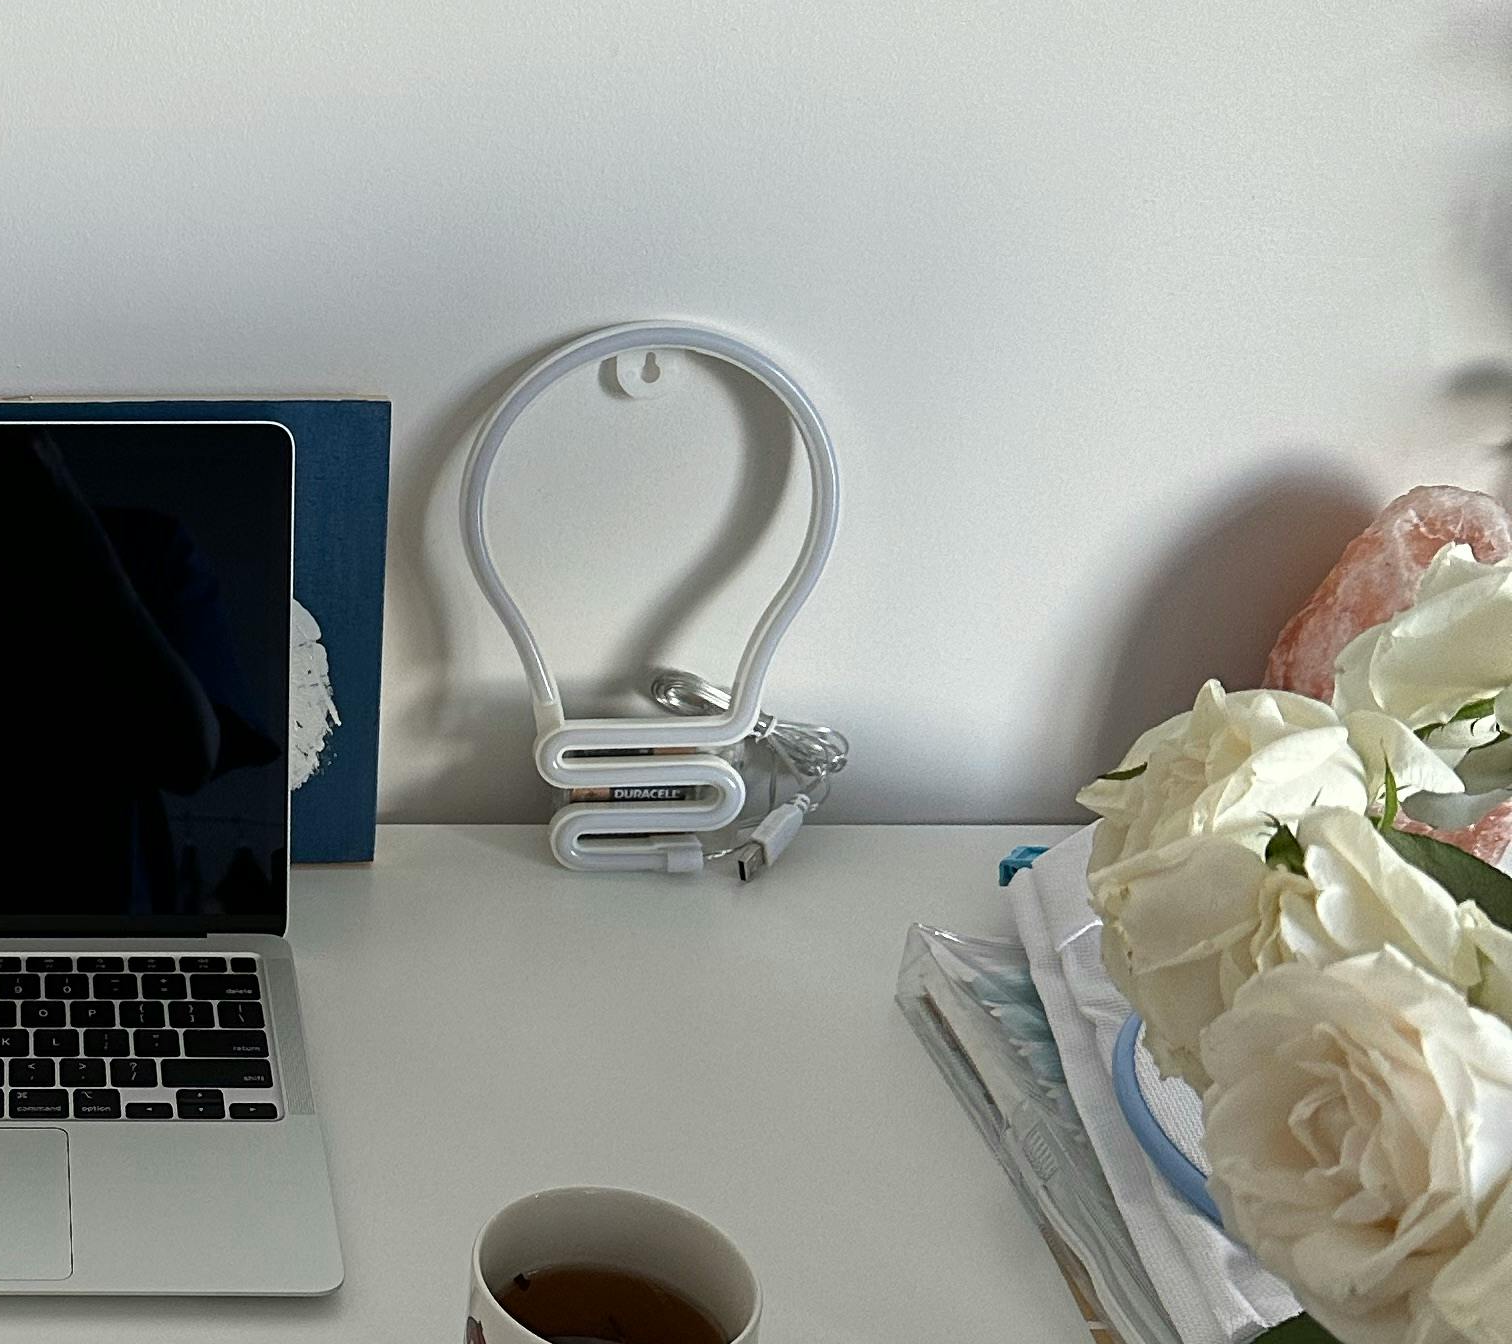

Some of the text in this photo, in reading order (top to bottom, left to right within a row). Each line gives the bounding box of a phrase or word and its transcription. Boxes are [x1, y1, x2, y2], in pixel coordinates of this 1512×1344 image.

[613, 788, 679, 799] DURACELL
[14, 985, 23, 994] 9
[62, 985, 72, 994] 0
[38, 1009, 49, 1017] O
[88, 1009, 97, 1017] P
[1, 1037, 10, 1046] K
[52, 1038, 61, 1046] L
